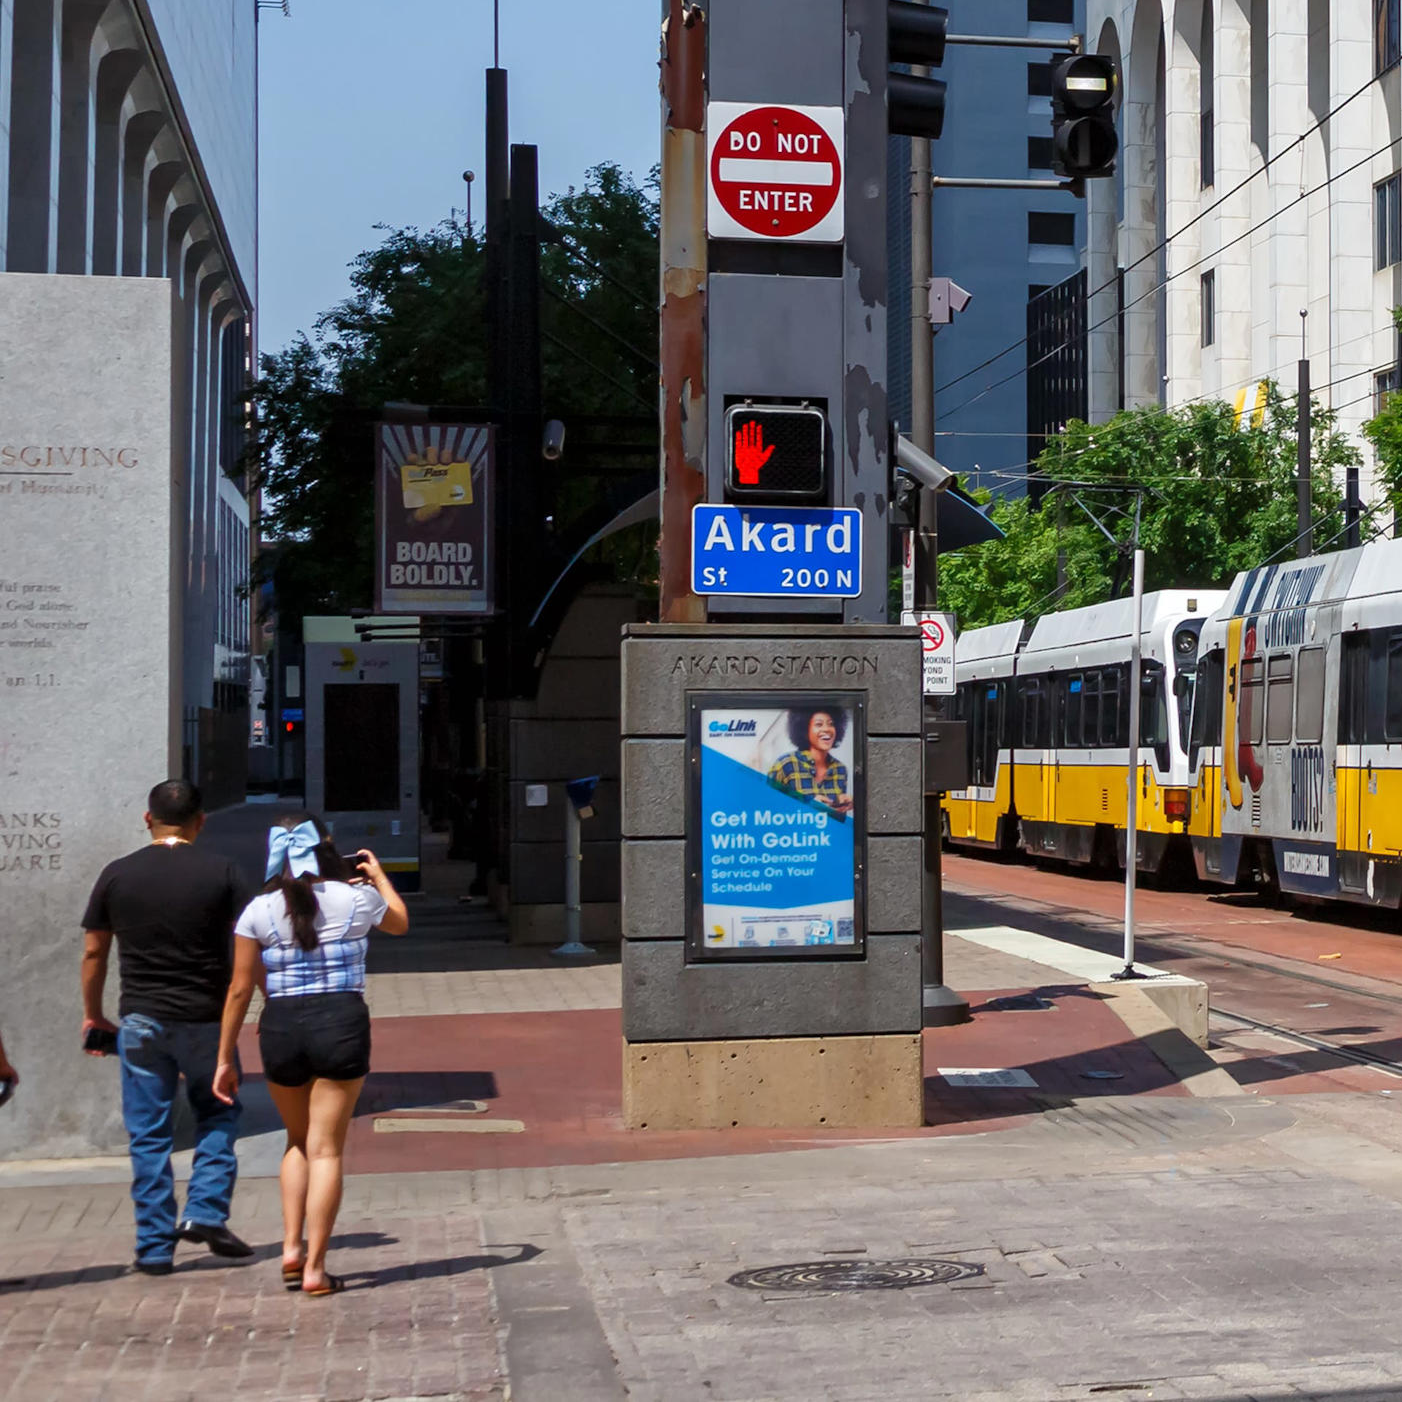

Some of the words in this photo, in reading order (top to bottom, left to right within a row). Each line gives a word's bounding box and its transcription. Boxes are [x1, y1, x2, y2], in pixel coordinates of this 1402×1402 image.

[730, 131, 761, 151] DO
[777, 133, 822, 154] NOT
[739, 190, 813, 212] ENTER
[1, 446, 138, 468] SGIVING
[703, 513, 851, 554] Akard
[396, 542, 472, 563] BOARD
[390, 564, 478, 586] BOLDLY.
[703, 567, 728, 586] St
[781, 569, 829, 588] 200
[836, 570, 852, 588] N
[6, 599, 34, 611] God
[671, 656, 761, 675] AKARD
[772, 655, 878, 675] STATION
[709, 719, 756, 732] GoLink
[1291, 746, 1324, 833] BOOTS?
[711, 811, 747, 827] Get
[754, 810, 828, 829] Moving
[711, 833, 755, 849] With
[762, 831, 831, 848] GoLink
[711, 854, 735, 865] Get
[739, 852, 817, 864] On-Demand
[711, 869, 760, 879] Service
[764, 867, 783, 877] On
[787, 867, 815, 877] Your
[711, 882, 772, 893] Schedule
